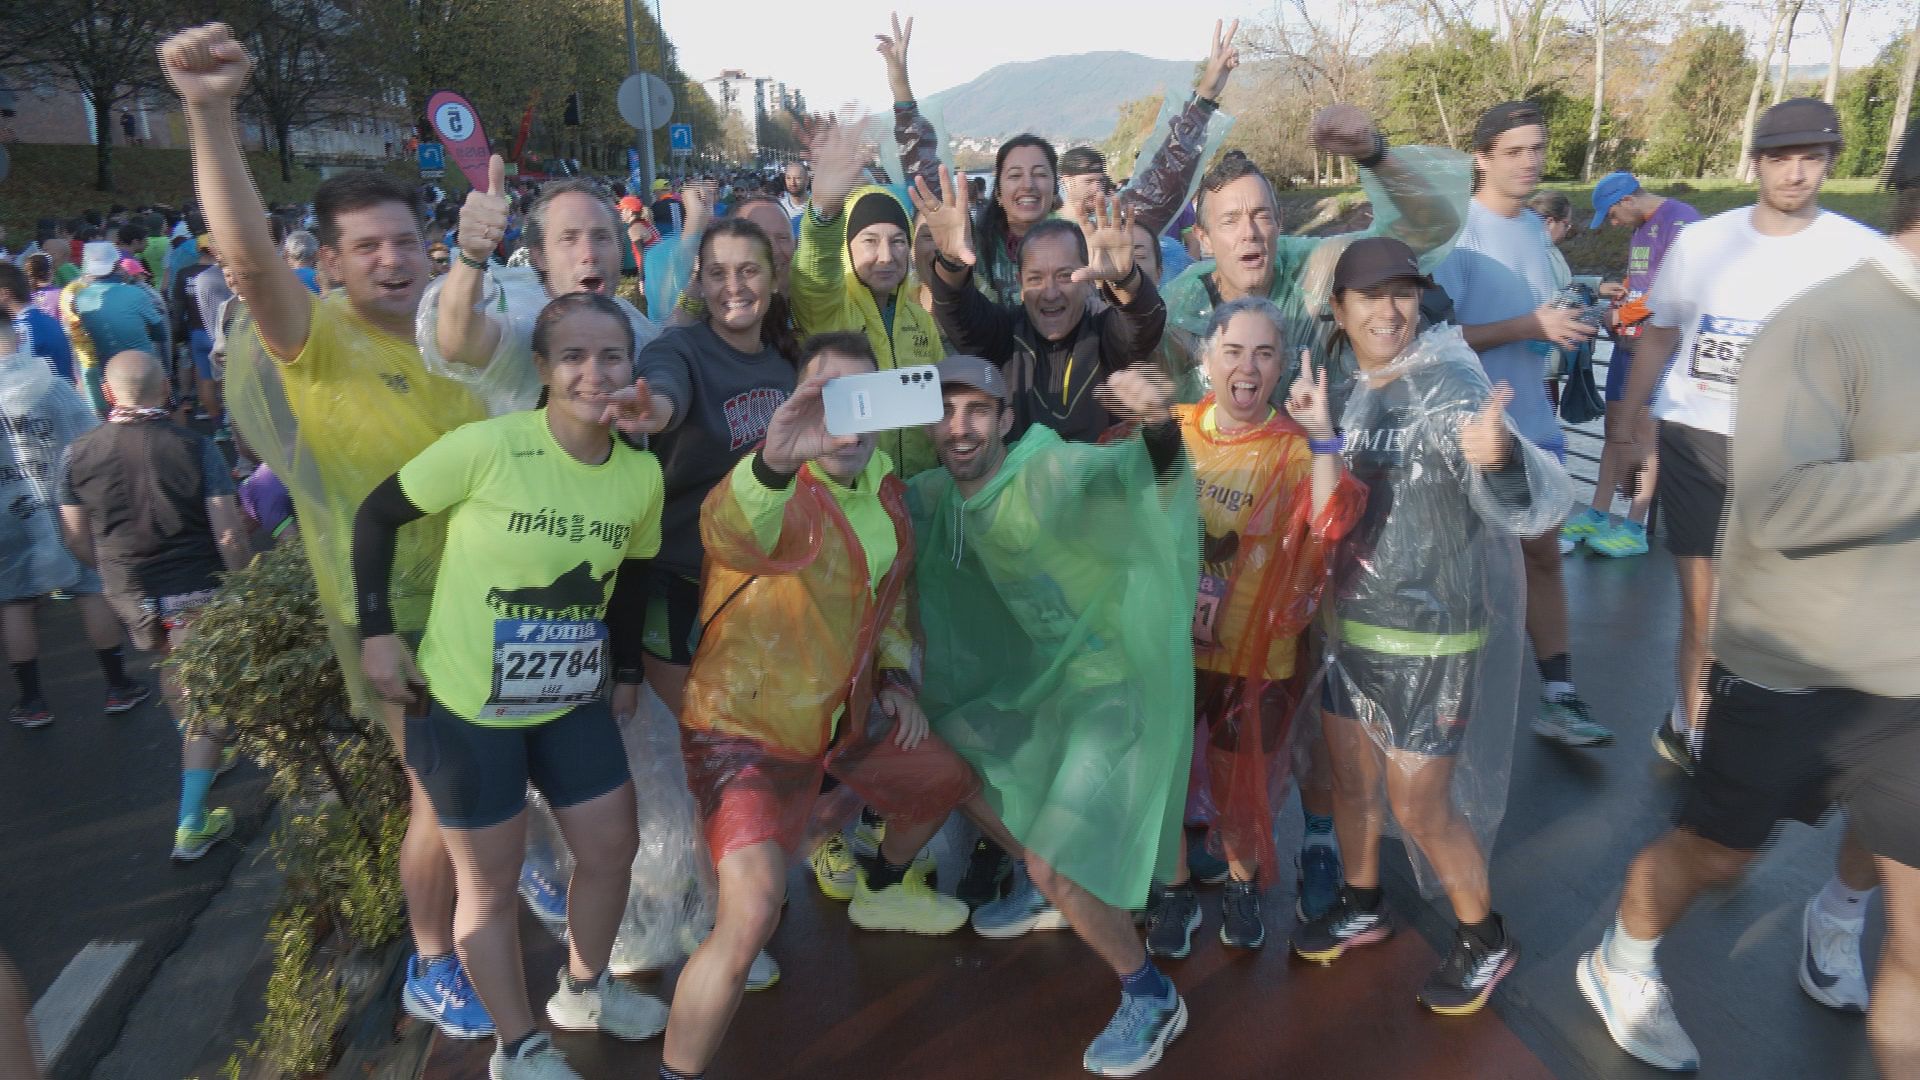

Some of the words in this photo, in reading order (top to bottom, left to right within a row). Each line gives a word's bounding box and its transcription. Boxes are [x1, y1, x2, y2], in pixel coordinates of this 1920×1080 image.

[1206, 484, 1254, 511] auga
[506, 507, 568, 538] máis
[504, 646, 601, 681] 22784
